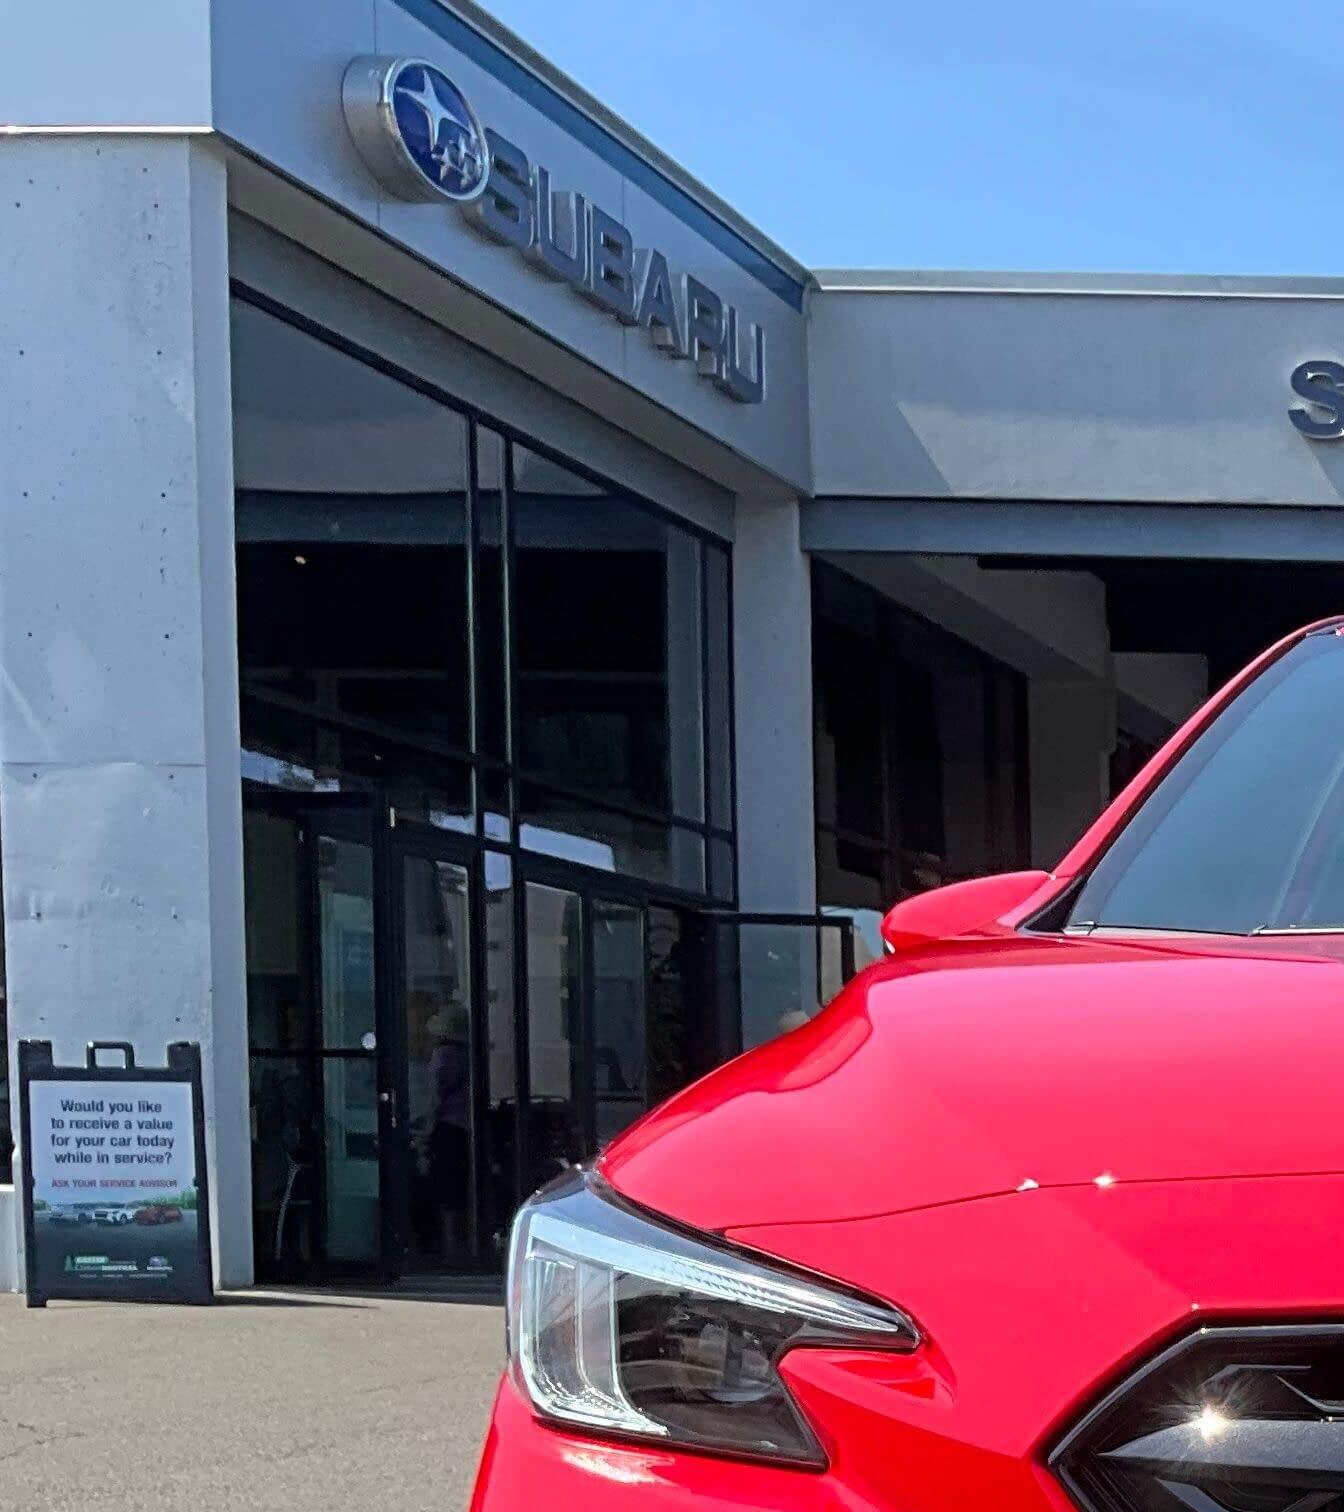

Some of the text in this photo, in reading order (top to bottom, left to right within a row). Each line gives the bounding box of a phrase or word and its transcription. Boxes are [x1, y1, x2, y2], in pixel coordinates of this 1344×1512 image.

[475, 127, 768, 402] SUBARU
[61, 1100, 162, 1114] Would you like
[51, 1118, 173, 1130] to receive a value
[51, 1134, 174, 1149] for your car today
[54, 1151, 172, 1164] while in service?
[52, 1179, 177, 1188] ASK YOUR SERVICE ADVISOR
